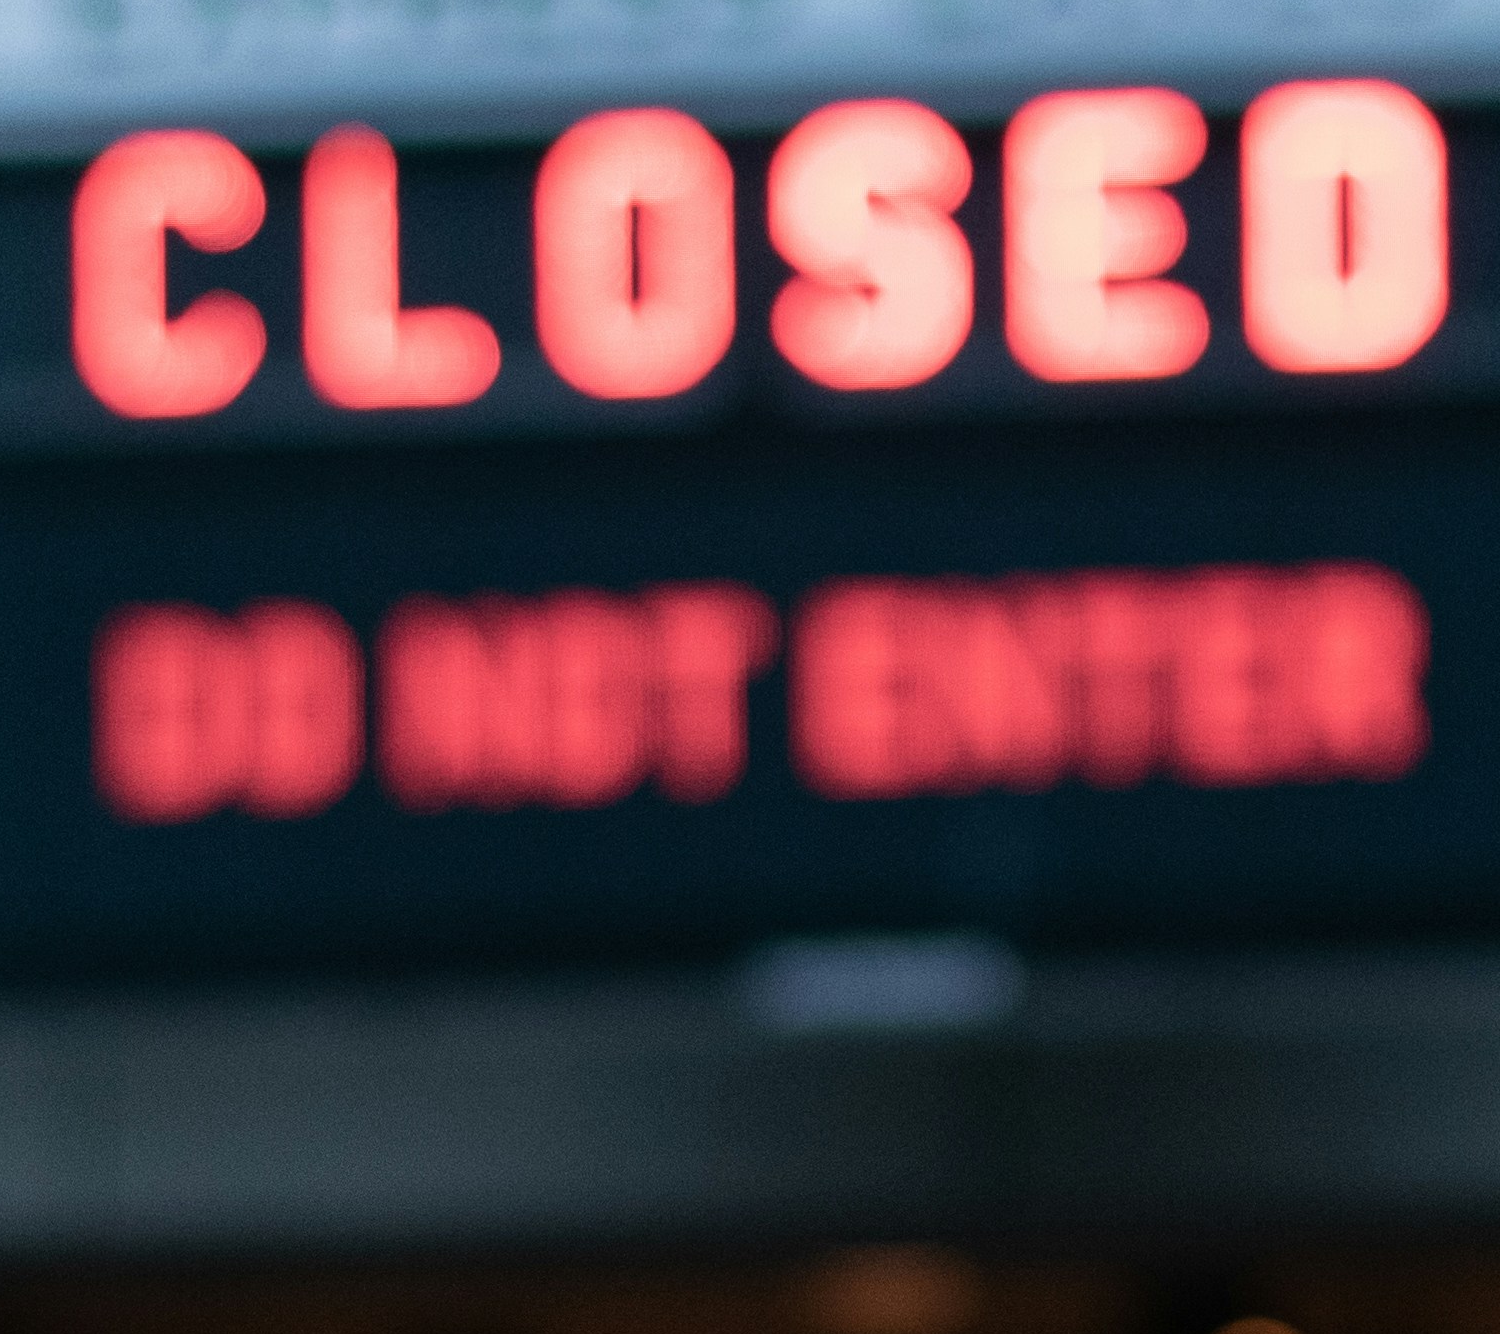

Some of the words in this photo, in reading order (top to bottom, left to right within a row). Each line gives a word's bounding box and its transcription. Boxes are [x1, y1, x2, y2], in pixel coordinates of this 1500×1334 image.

[70, 75, 1450, 419] CLOSED
[90, 597, 367, 825] DO
[371, 579, 778, 812] NOT
[787, 559, 1433, 801] ENTER
